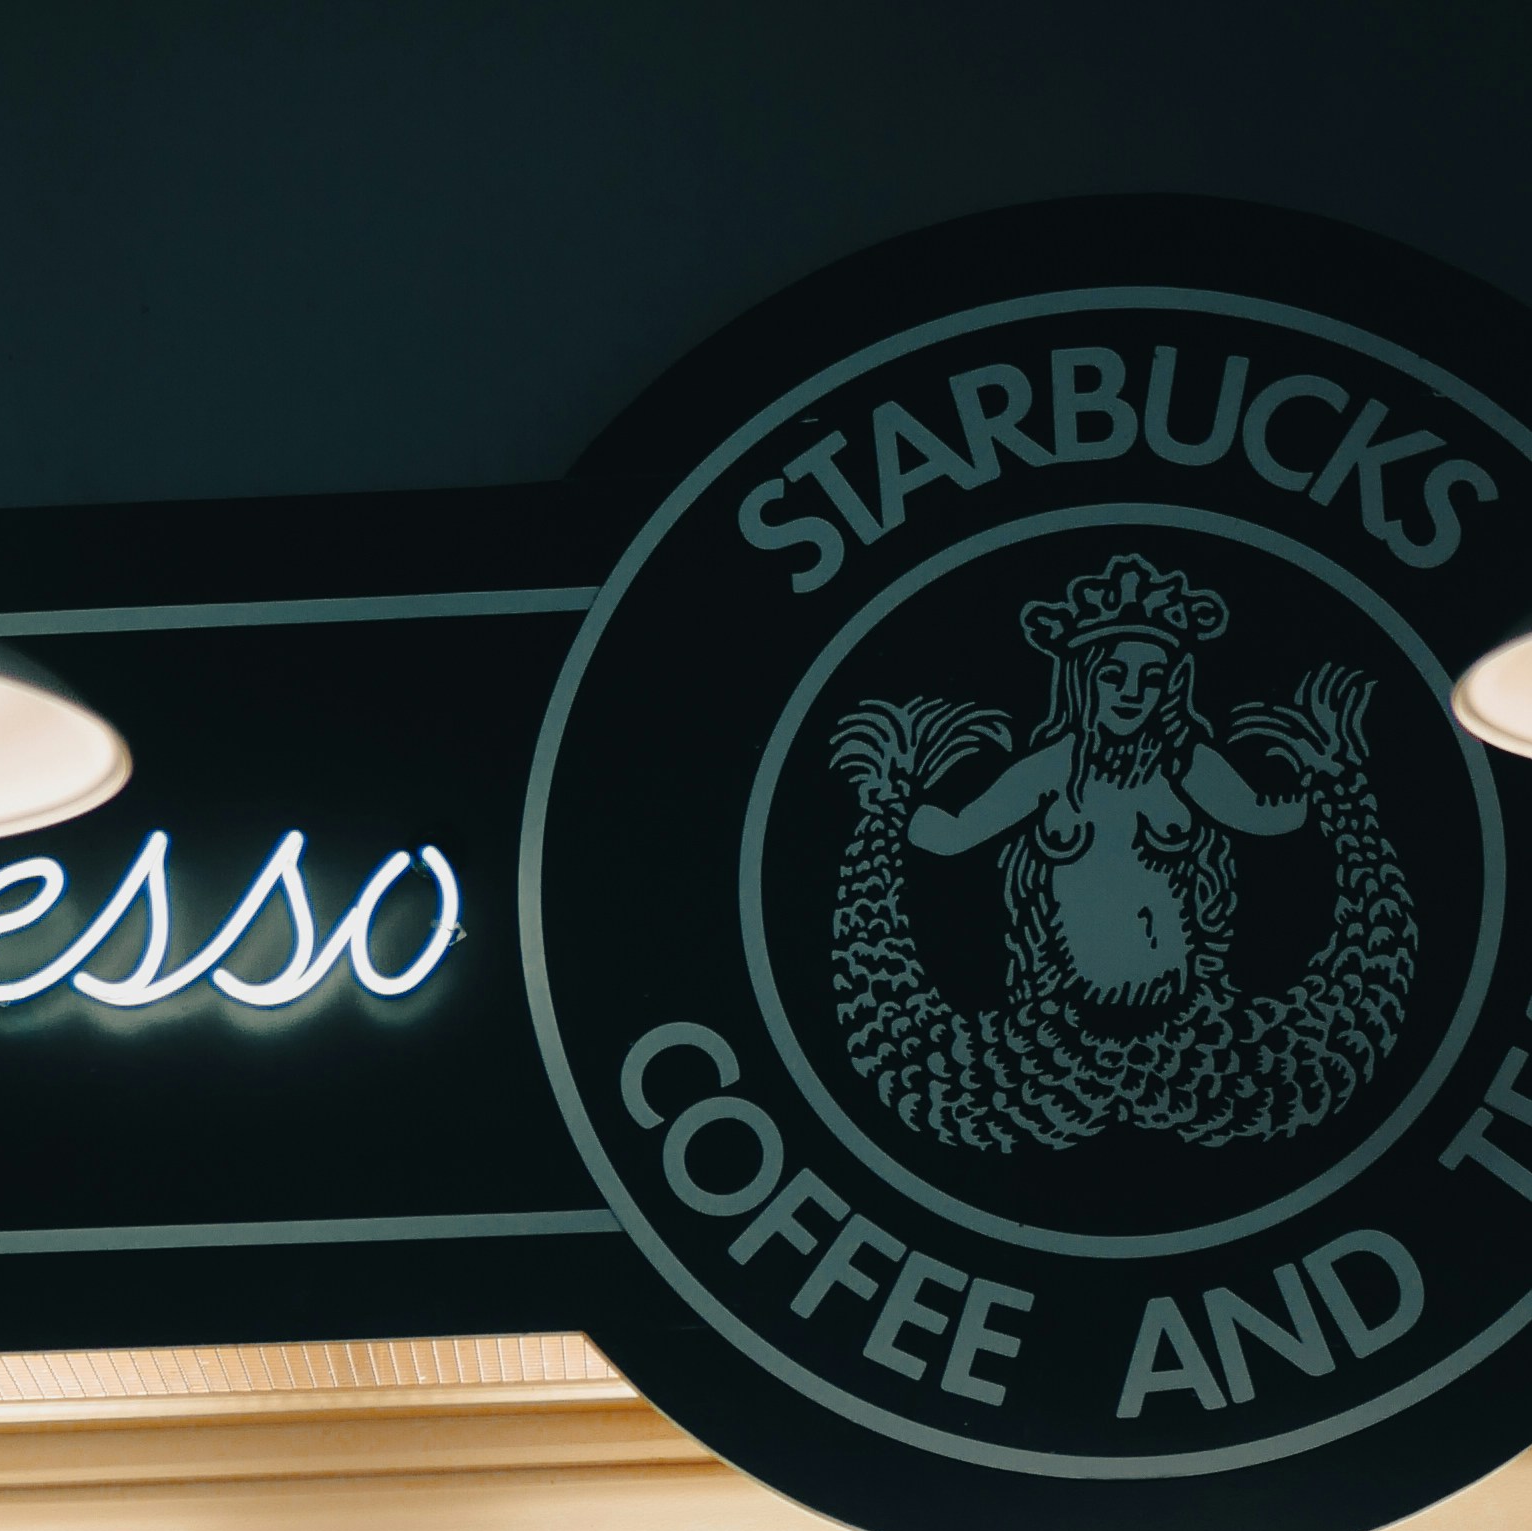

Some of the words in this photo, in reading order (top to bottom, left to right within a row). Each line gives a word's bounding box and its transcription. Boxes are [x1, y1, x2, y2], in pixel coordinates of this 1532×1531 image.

[738, 344, 1499, 594] STARBUCKS
[620, 1020, 1035, 1408] COFFEE
[1115, 1227, 1426, 1420] AND
